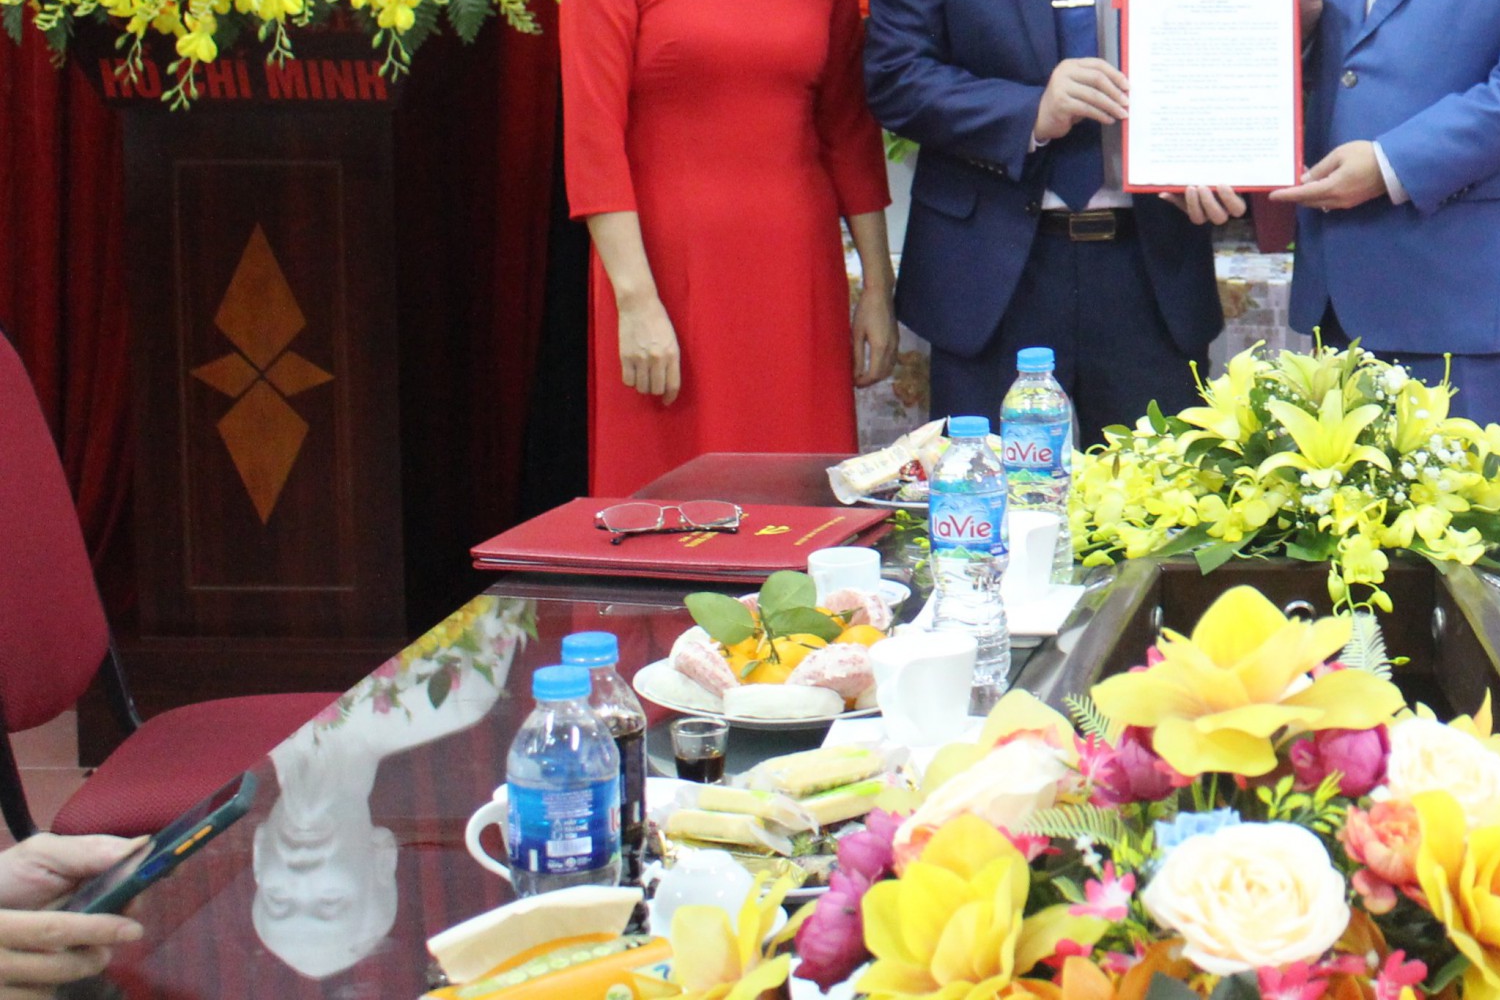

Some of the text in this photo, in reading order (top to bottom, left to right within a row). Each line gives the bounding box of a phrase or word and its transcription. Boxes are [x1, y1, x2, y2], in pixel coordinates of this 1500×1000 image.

[265, 58, 390, 100] MINH
[1005, 441, 1052, 462] aVie
[934, 514, 991, 537] laVie
